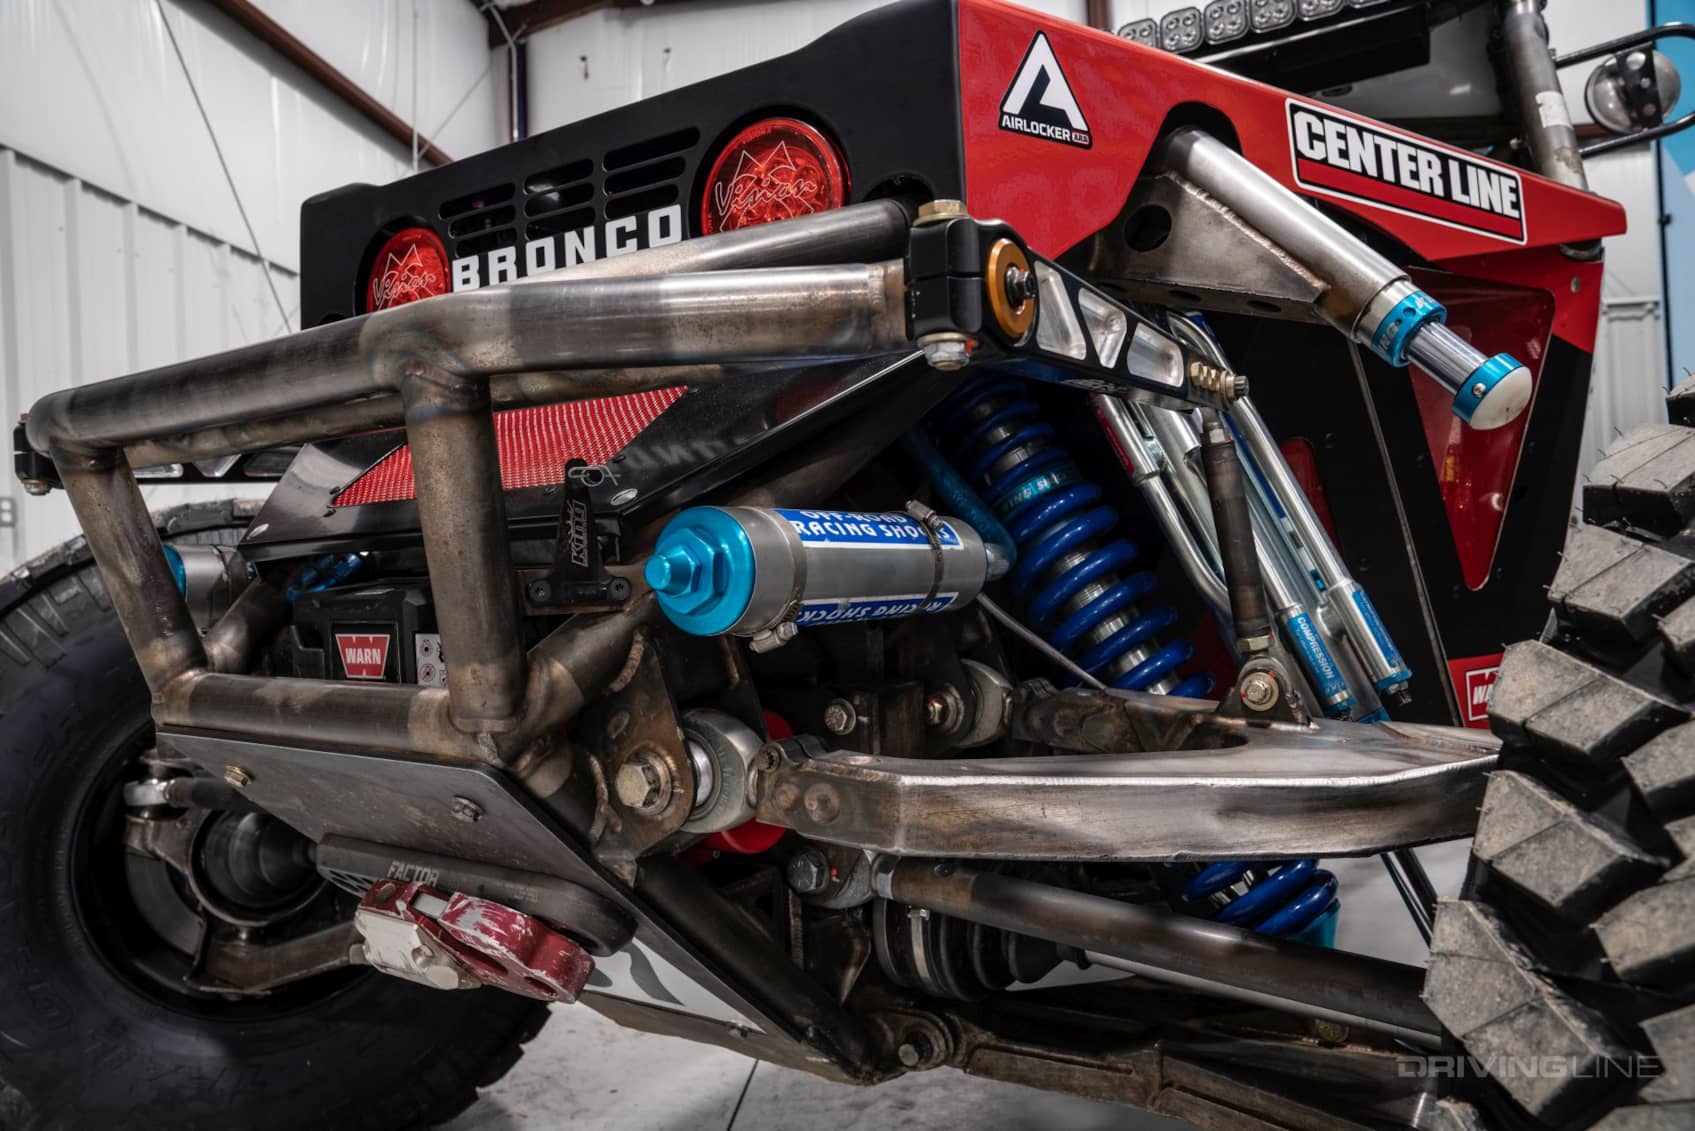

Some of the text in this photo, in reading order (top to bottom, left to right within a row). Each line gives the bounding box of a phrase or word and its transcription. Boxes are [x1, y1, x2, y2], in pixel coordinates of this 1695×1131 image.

[1002, 114, 1071, 142] AIRLOCKER
[1294, 111, 1520, 219] CENTER LINE
[453, 204, 682, 293] BRONCO
[790, 520, 951, 540] RACING SHOS
[796, 601, 943, 622] RCING SHOCK
[345, 648, 381, 665] WARN
[1297, 616, 1336, 679] COMPRESSION
[387, 861, 440, 887] FACTOR
